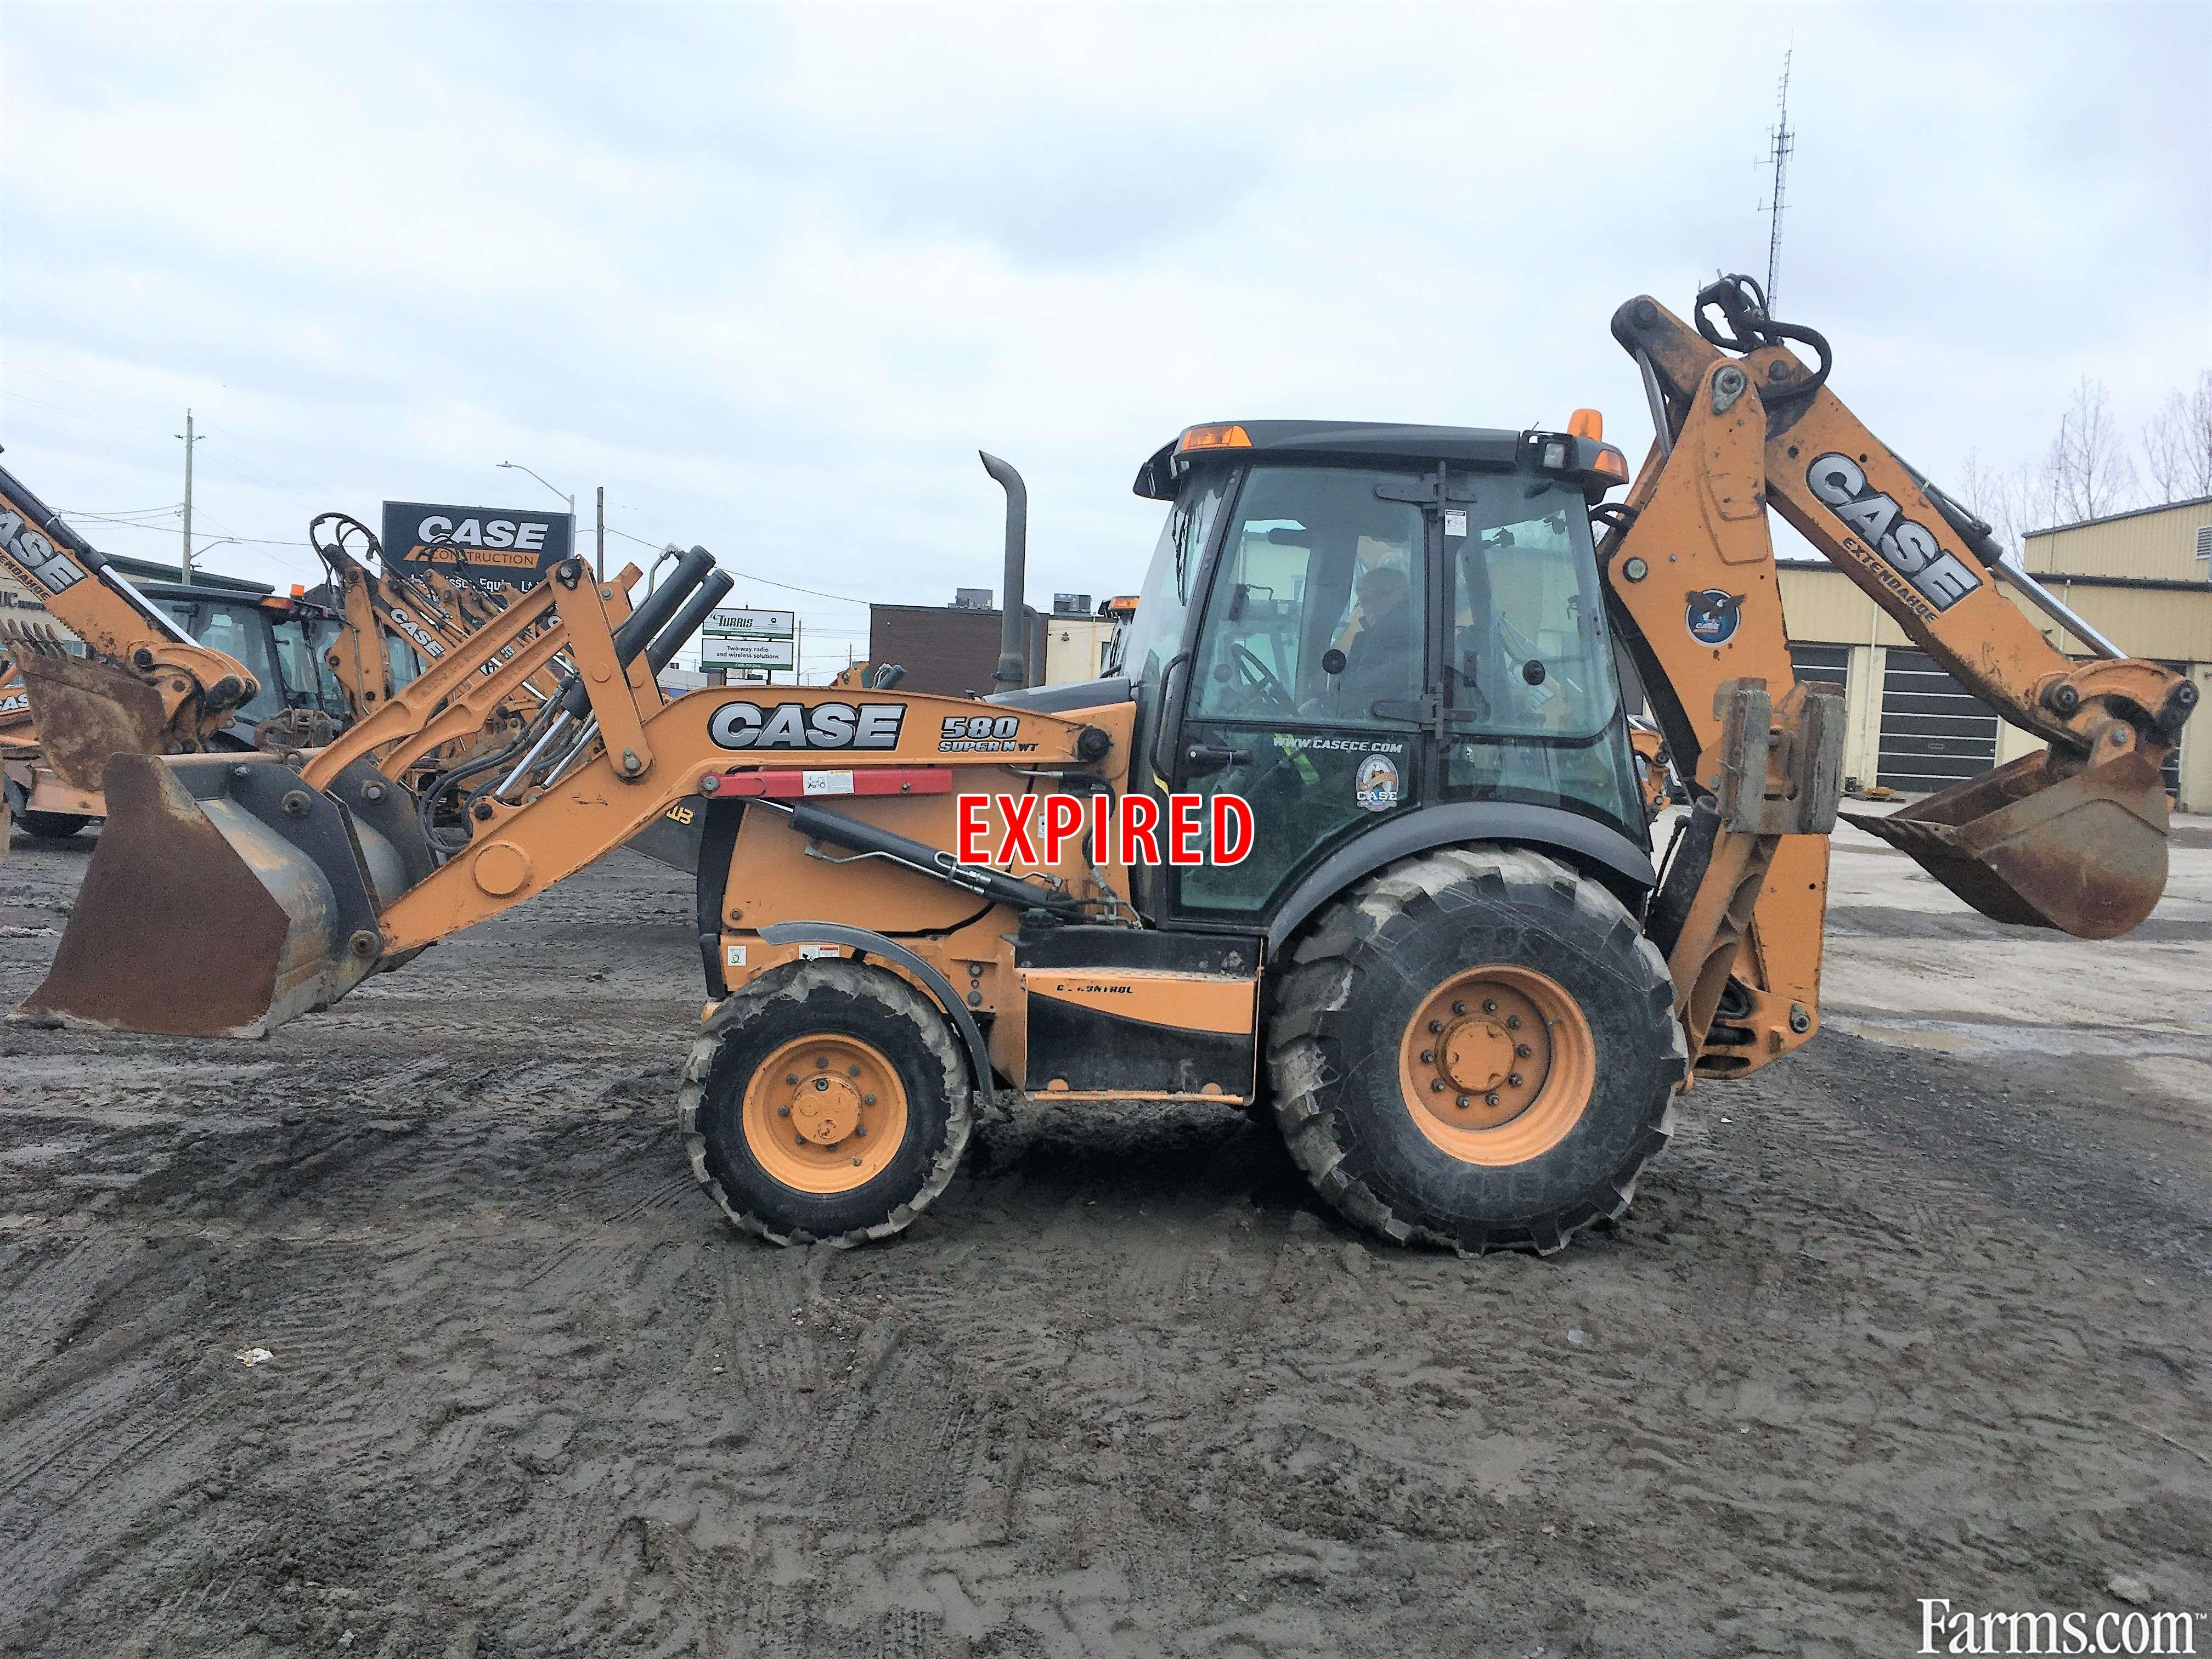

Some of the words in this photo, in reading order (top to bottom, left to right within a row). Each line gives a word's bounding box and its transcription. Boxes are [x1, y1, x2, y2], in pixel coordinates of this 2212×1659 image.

[418, 516, 549, 550] CASE
[1808, 454, 1980, 611] CASE
[0, 511, 86, 594] ASE
[1842, 537, 1938, 623] EXTENDAHOE
[390, 609, 445, 657] CASE
[717, 615, 753, 628] TURRIS
[709, 702, 906, 749] CASE
[941, 716, 1019, 739] 580
[939, 740, 1000, 752] SUPER
[1001, 740, 1017, 752] N
[1018, 743, 1039, 752] WT
[1273, 737, 1403, 753] WWW.CASECE.COM
[1357, 791, 1397, 800] CASE
